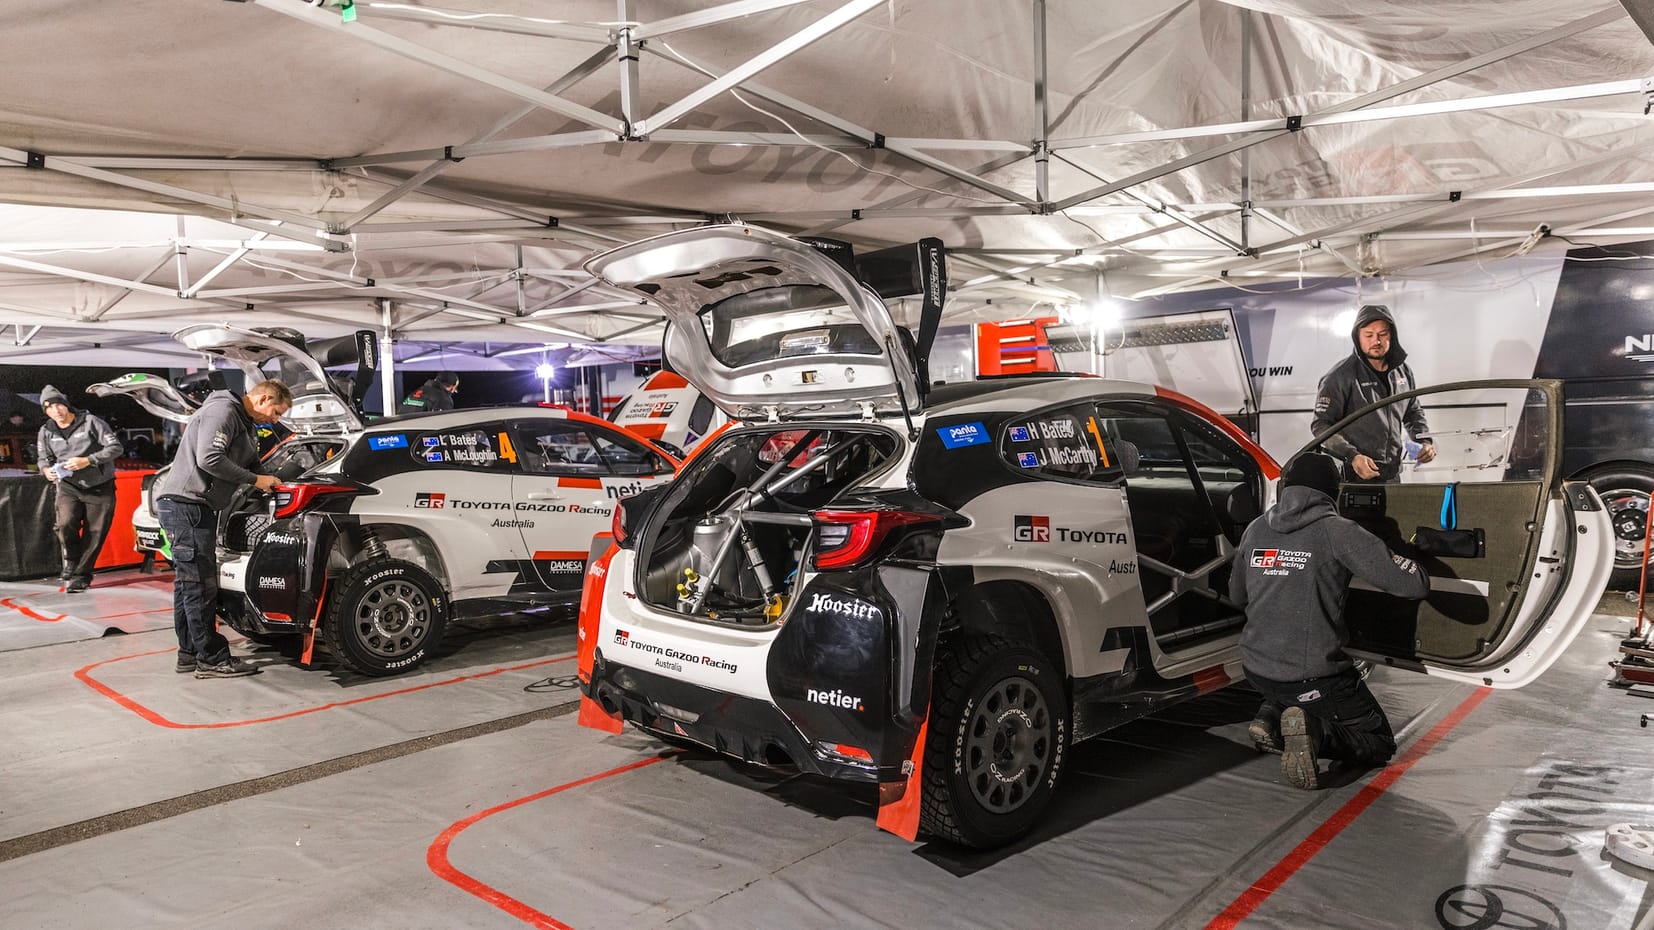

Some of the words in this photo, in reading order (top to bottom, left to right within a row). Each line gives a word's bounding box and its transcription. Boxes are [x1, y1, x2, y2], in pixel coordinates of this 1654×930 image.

[1624, 334, 1654, 353] N
[1249, 367, 1267, 378] OU
[1269, 366, 1293, 377] WIN
[449, 433, 478, 446] Bates
[1027, 422, 1039, 440] H
[498, 432, 517, 464] 4
[1087, 416, 1110, 468] 1
[444, 450, 452, 461] A
[453, 450, 498, 463] McLoughlin
[1040, 453, 1048, 466] J
[1051, 448, 1097, 470] McCarthy
[450, 499, 511, 511] TOYOTA
[515, 501, 566, 513] GAZOO
[568, 504, 612, 518] Racing
[490, 518, 535, 529] Australia
[1056, 528, 1128, 544] TOYOTA
[1276, 556, 1307, 564] GAZOO
[1279, 550, 1312, 558] TOYOTA
[550, 561, 583, 570] DAMESA
[1262, 568, 1289, 576] Australia
[1275, 561, 1305, 570] Racing
[259, 577, 286, 586] DAMESA
[363, 568, 404, 586] Hoosier
[806, 592, 879, 620] Hoosier
[385, 649, 425, 669] Hoosier
[629, 639, 664, 656] TOYOTA
[664, 648, 700, 664] GAZOO
[701, 655, 738, 674] Racing
[654, 657, 683, 673] Australia
[807, 688, 865, 711] netier.
[955, 698, 974, 776] Hoosier
[1048, 718, 1065, 789] Hoosier
